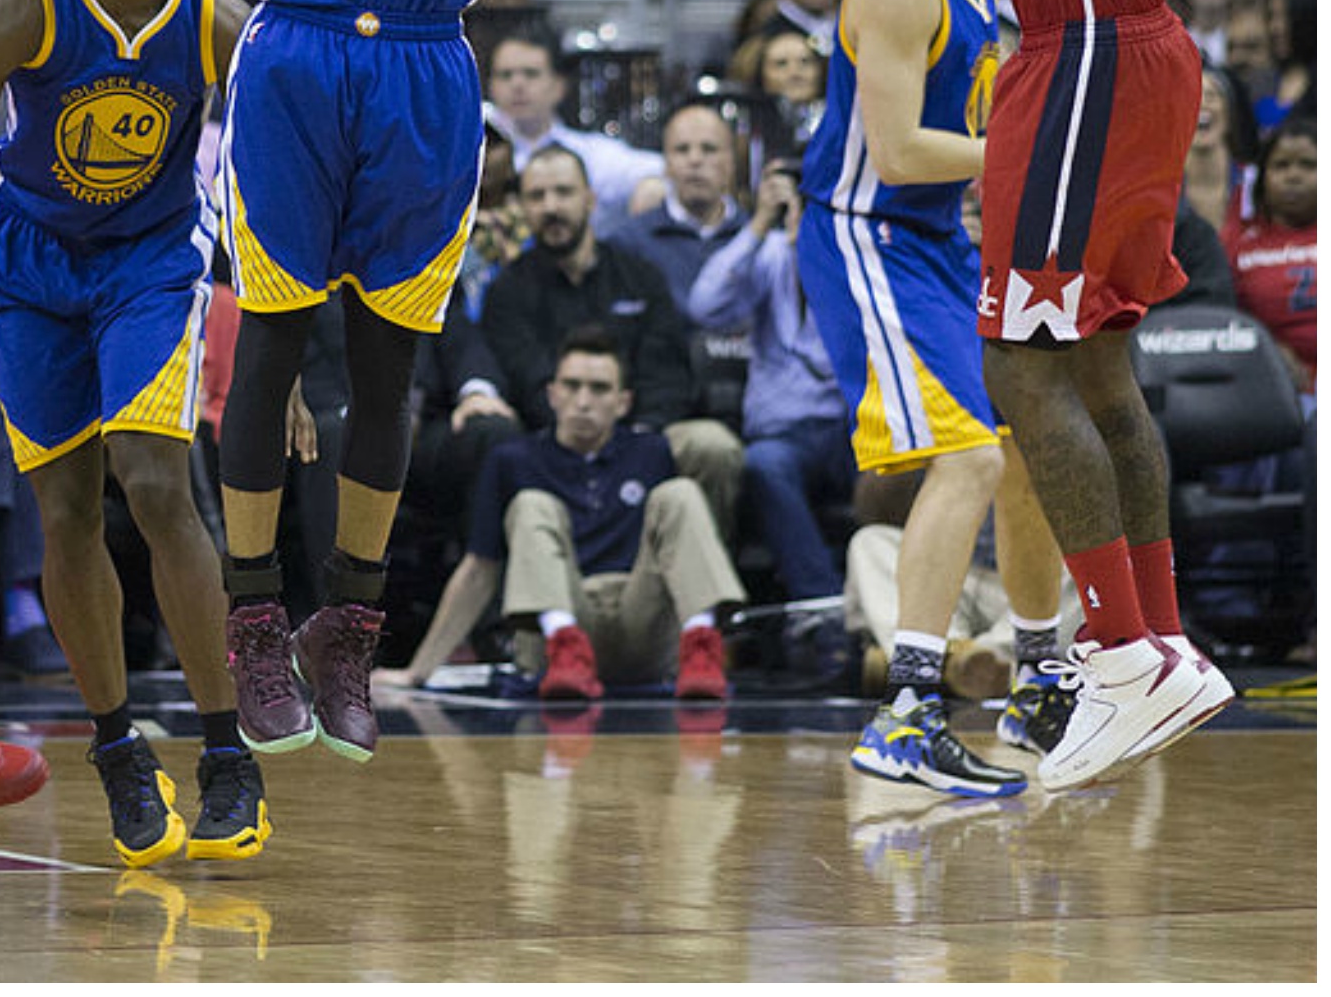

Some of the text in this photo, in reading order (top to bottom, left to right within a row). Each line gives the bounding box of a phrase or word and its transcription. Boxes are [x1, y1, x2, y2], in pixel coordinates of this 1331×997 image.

[60, 76, 131, 106] GOLDEN
[112, 113, 156, 138] 40
[50, 159, 164, 206] WARRIORS
[1136, 319, 1258, 354] wizards
